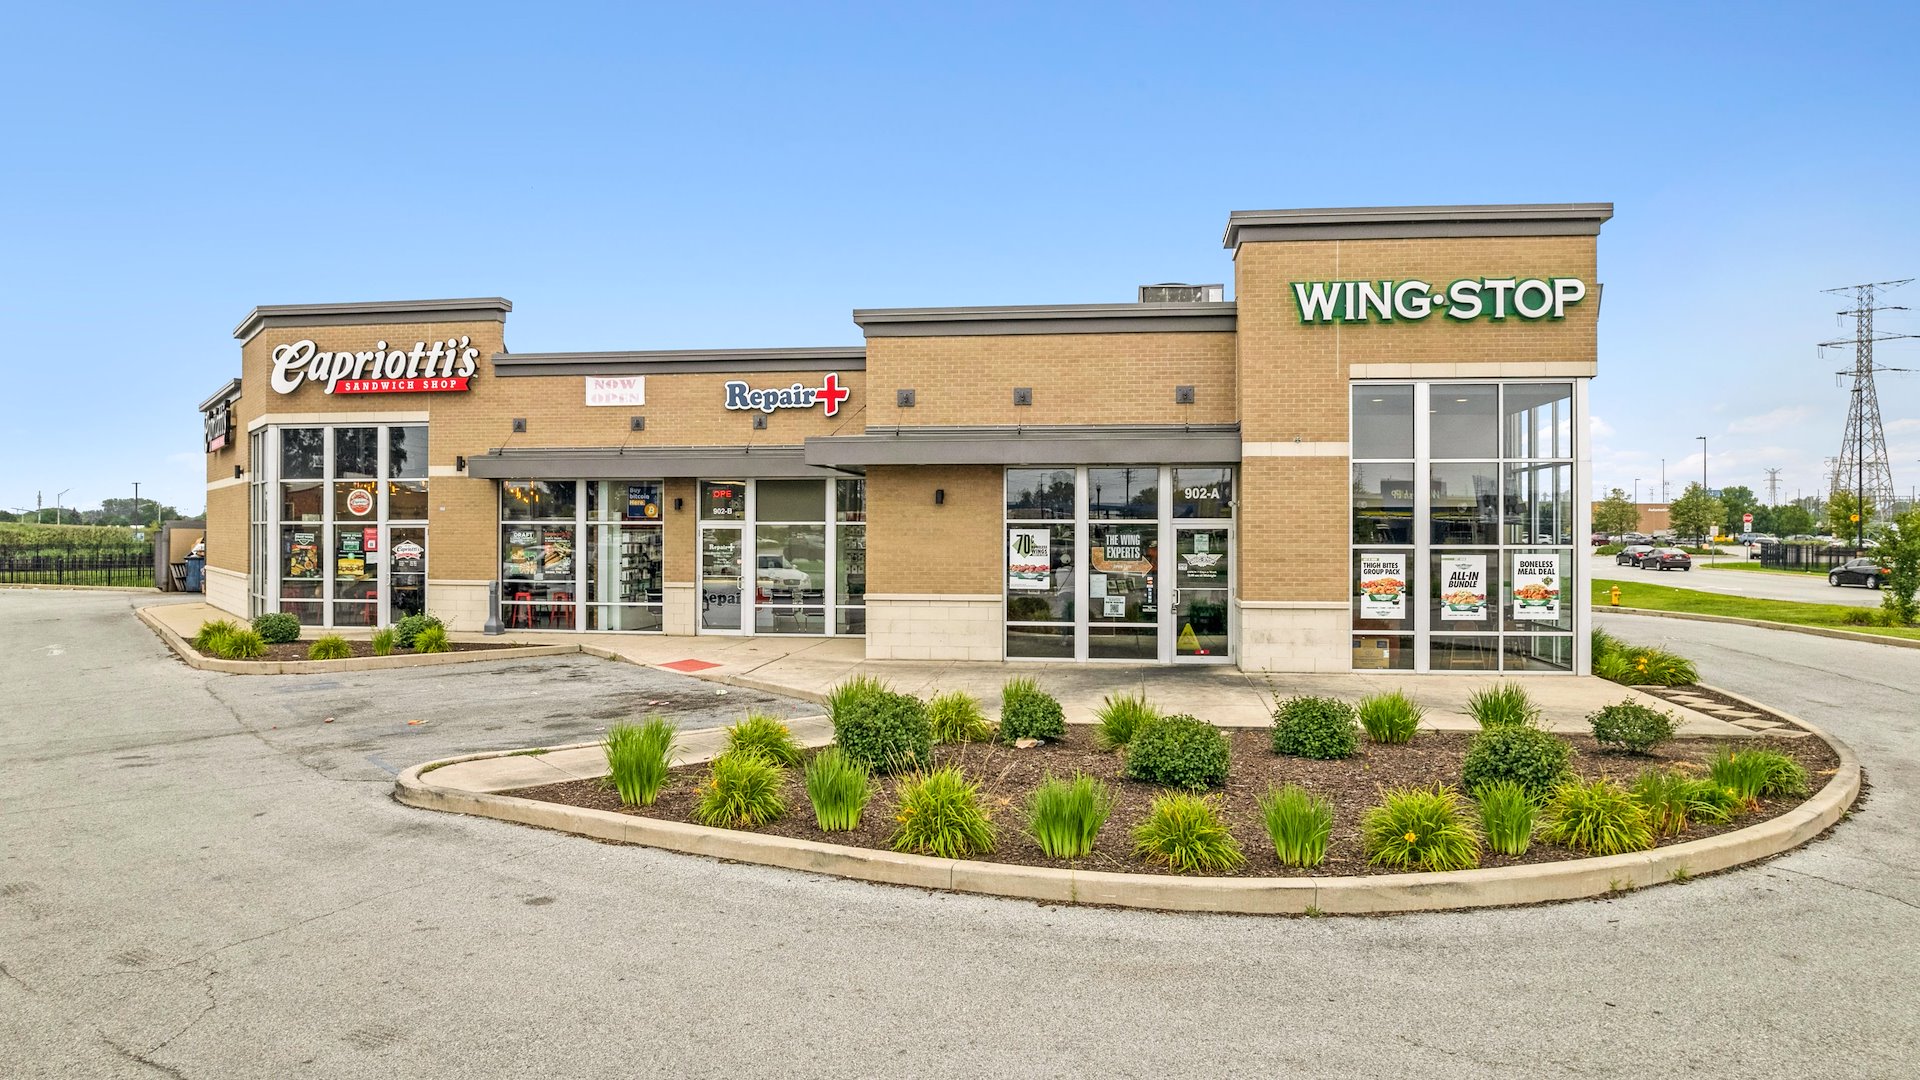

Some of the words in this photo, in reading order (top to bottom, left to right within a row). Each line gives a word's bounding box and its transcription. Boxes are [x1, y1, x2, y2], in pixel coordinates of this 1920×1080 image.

[270, 335, 479, 395] Capriotti's
[345, 381, 415, 391] SANDWICH
[423, 379, 457, 389] SHOP
[594, 379, 636, 389] NOW
[591, 393, 640, 403] OPEN
[1184, 487, 1220, 499] 902-A
[1105, 534, 1119, 546] THE
[1120, 534, 1141, 546] WING
[1106, 546, 1141, 559] EXPERTS
[1519, 560, 1554, 568] BONELESS
[1450, 571, 1480, 581] ALL-IN
[1448, 580, 1478, 588] BUNDLE
